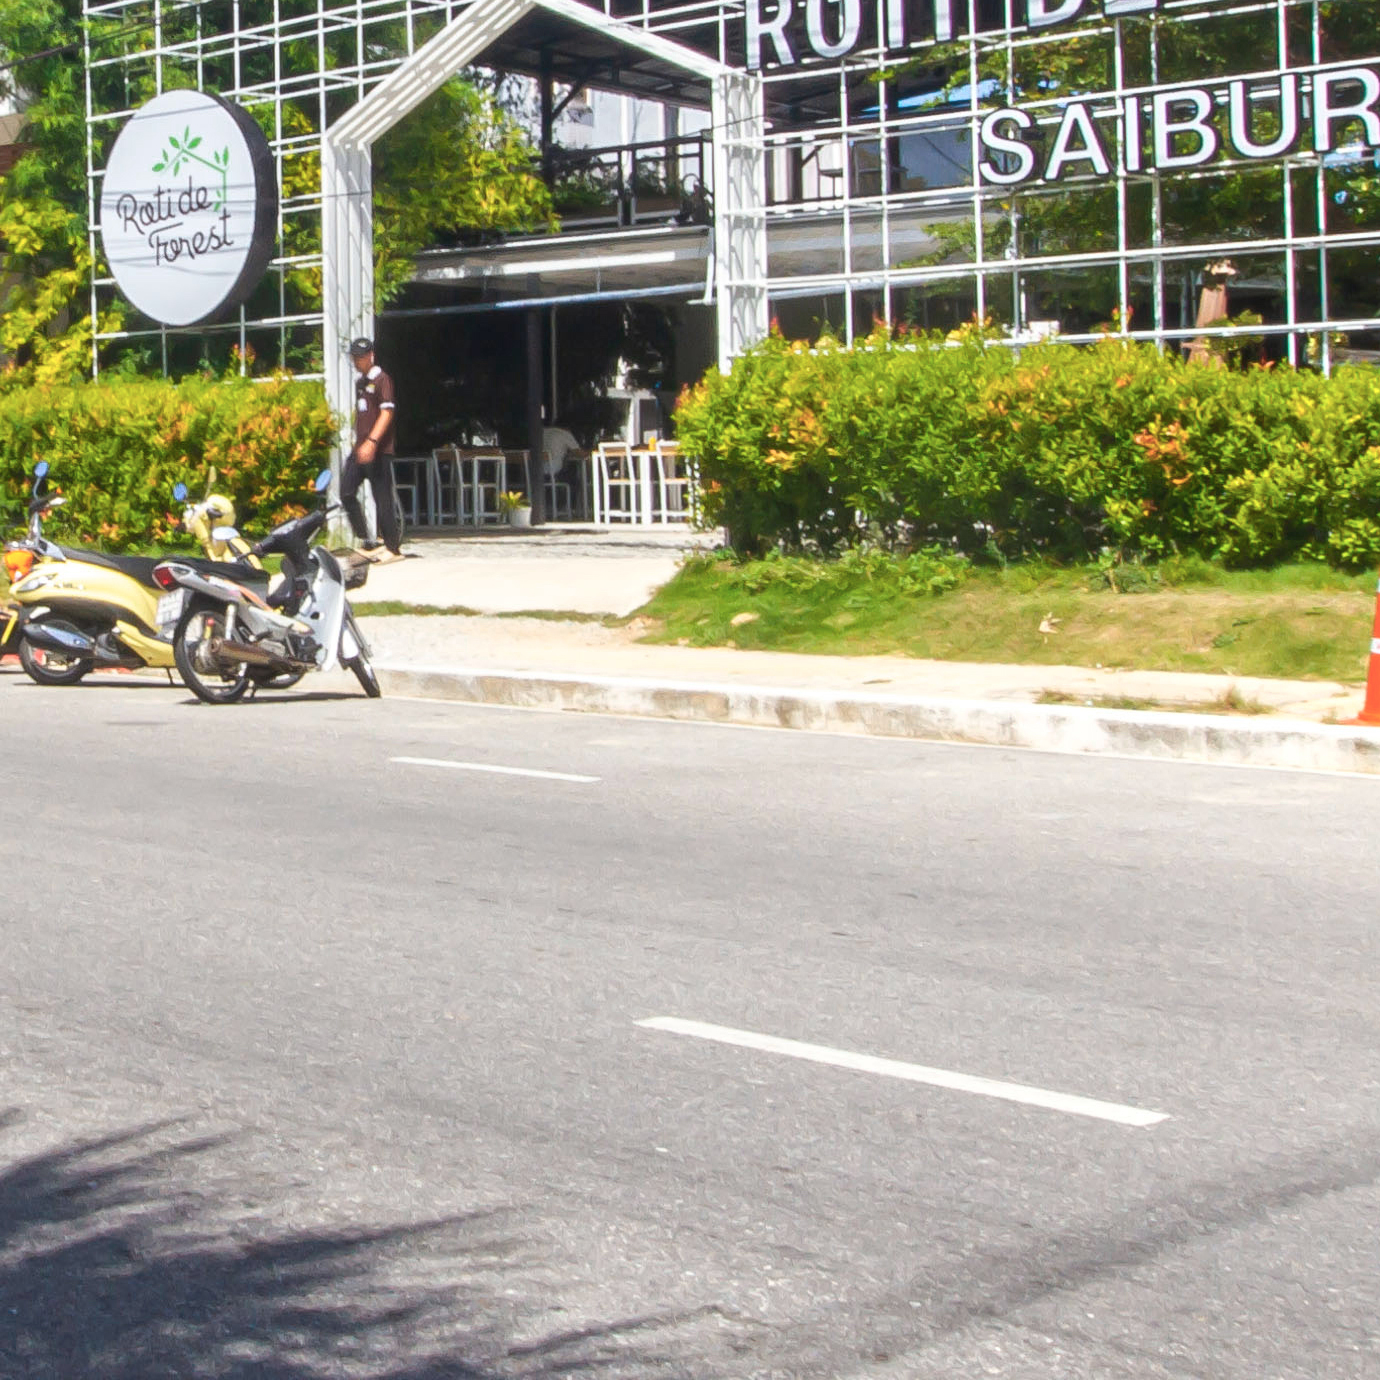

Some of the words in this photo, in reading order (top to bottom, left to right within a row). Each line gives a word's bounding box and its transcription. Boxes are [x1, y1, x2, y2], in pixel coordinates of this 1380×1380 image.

[116, 185, 176, 235] Roti
[178, 175, 212, 215] de
[149, 207, 234, 265] Forest
